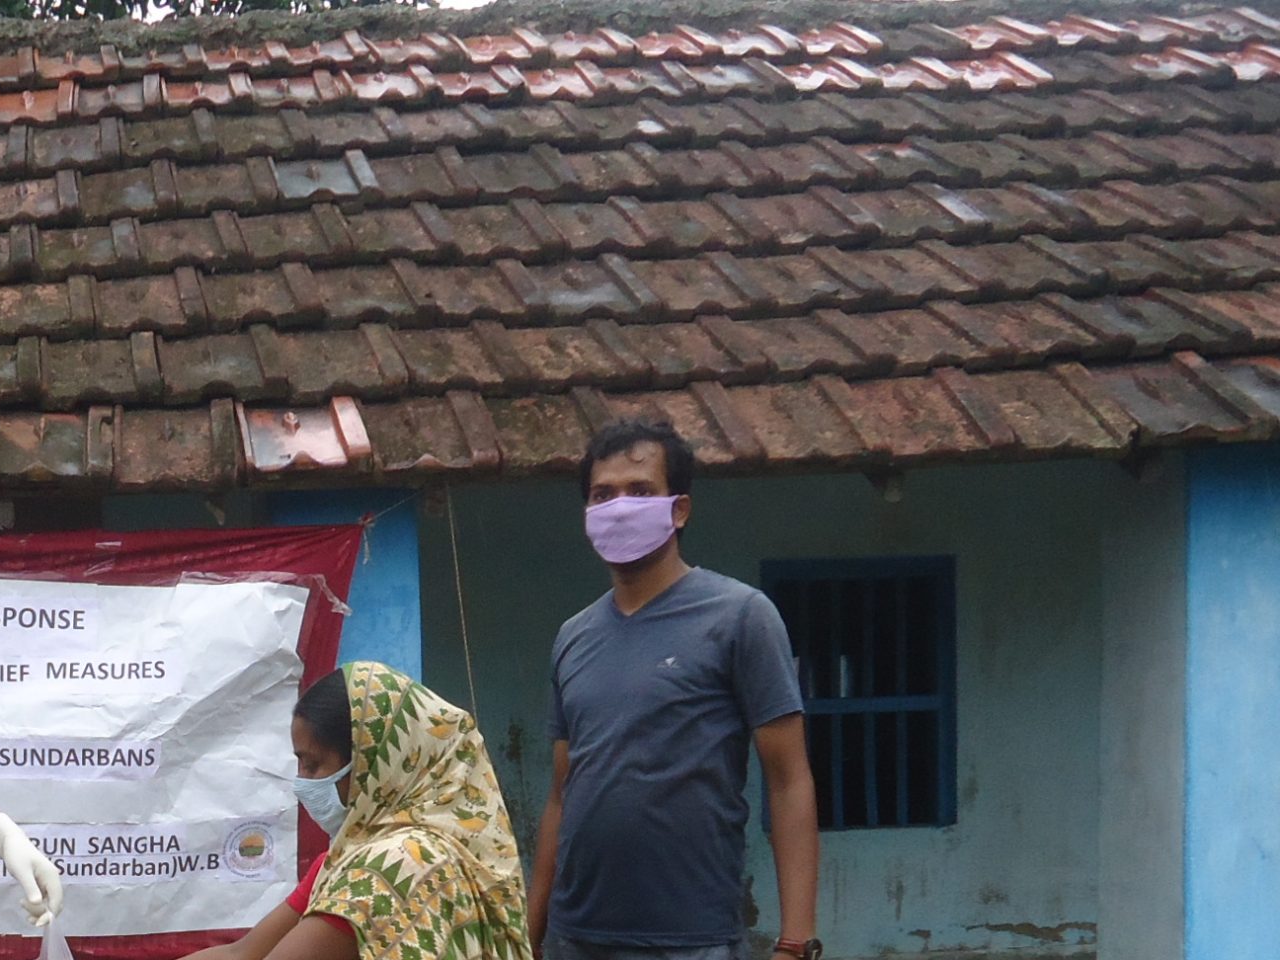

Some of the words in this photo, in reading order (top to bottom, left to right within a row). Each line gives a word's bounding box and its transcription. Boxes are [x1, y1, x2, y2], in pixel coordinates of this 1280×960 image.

[46, 660, 166, 680] MEASURES
[0, 748, 155, 767] SUNDARBANS
[88, 835, 181, 854] SANGHA
